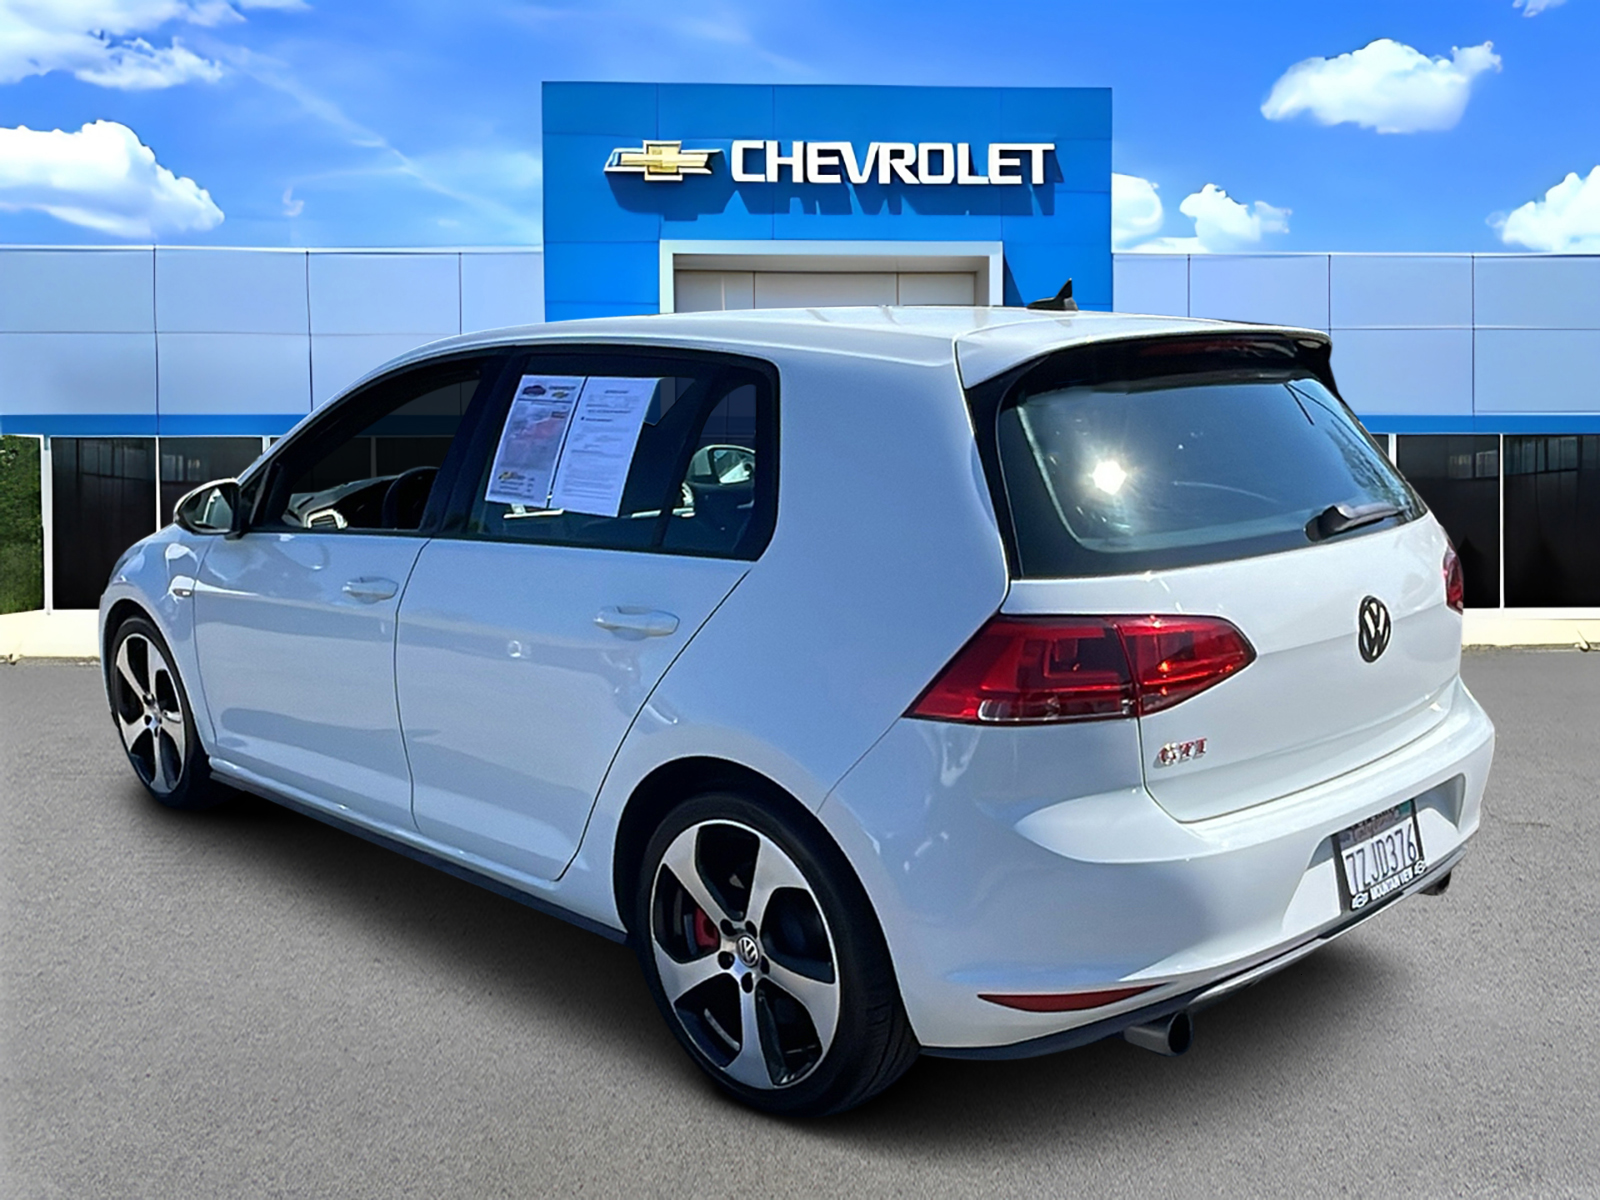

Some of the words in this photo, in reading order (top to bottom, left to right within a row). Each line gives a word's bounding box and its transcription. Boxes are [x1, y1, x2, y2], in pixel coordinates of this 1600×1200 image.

[731, 140, 1055, 185] CHEVROLET
[1158, 737, 1207, 765] GTI
[1345, 823, 1416, 892] 7ZJD376
